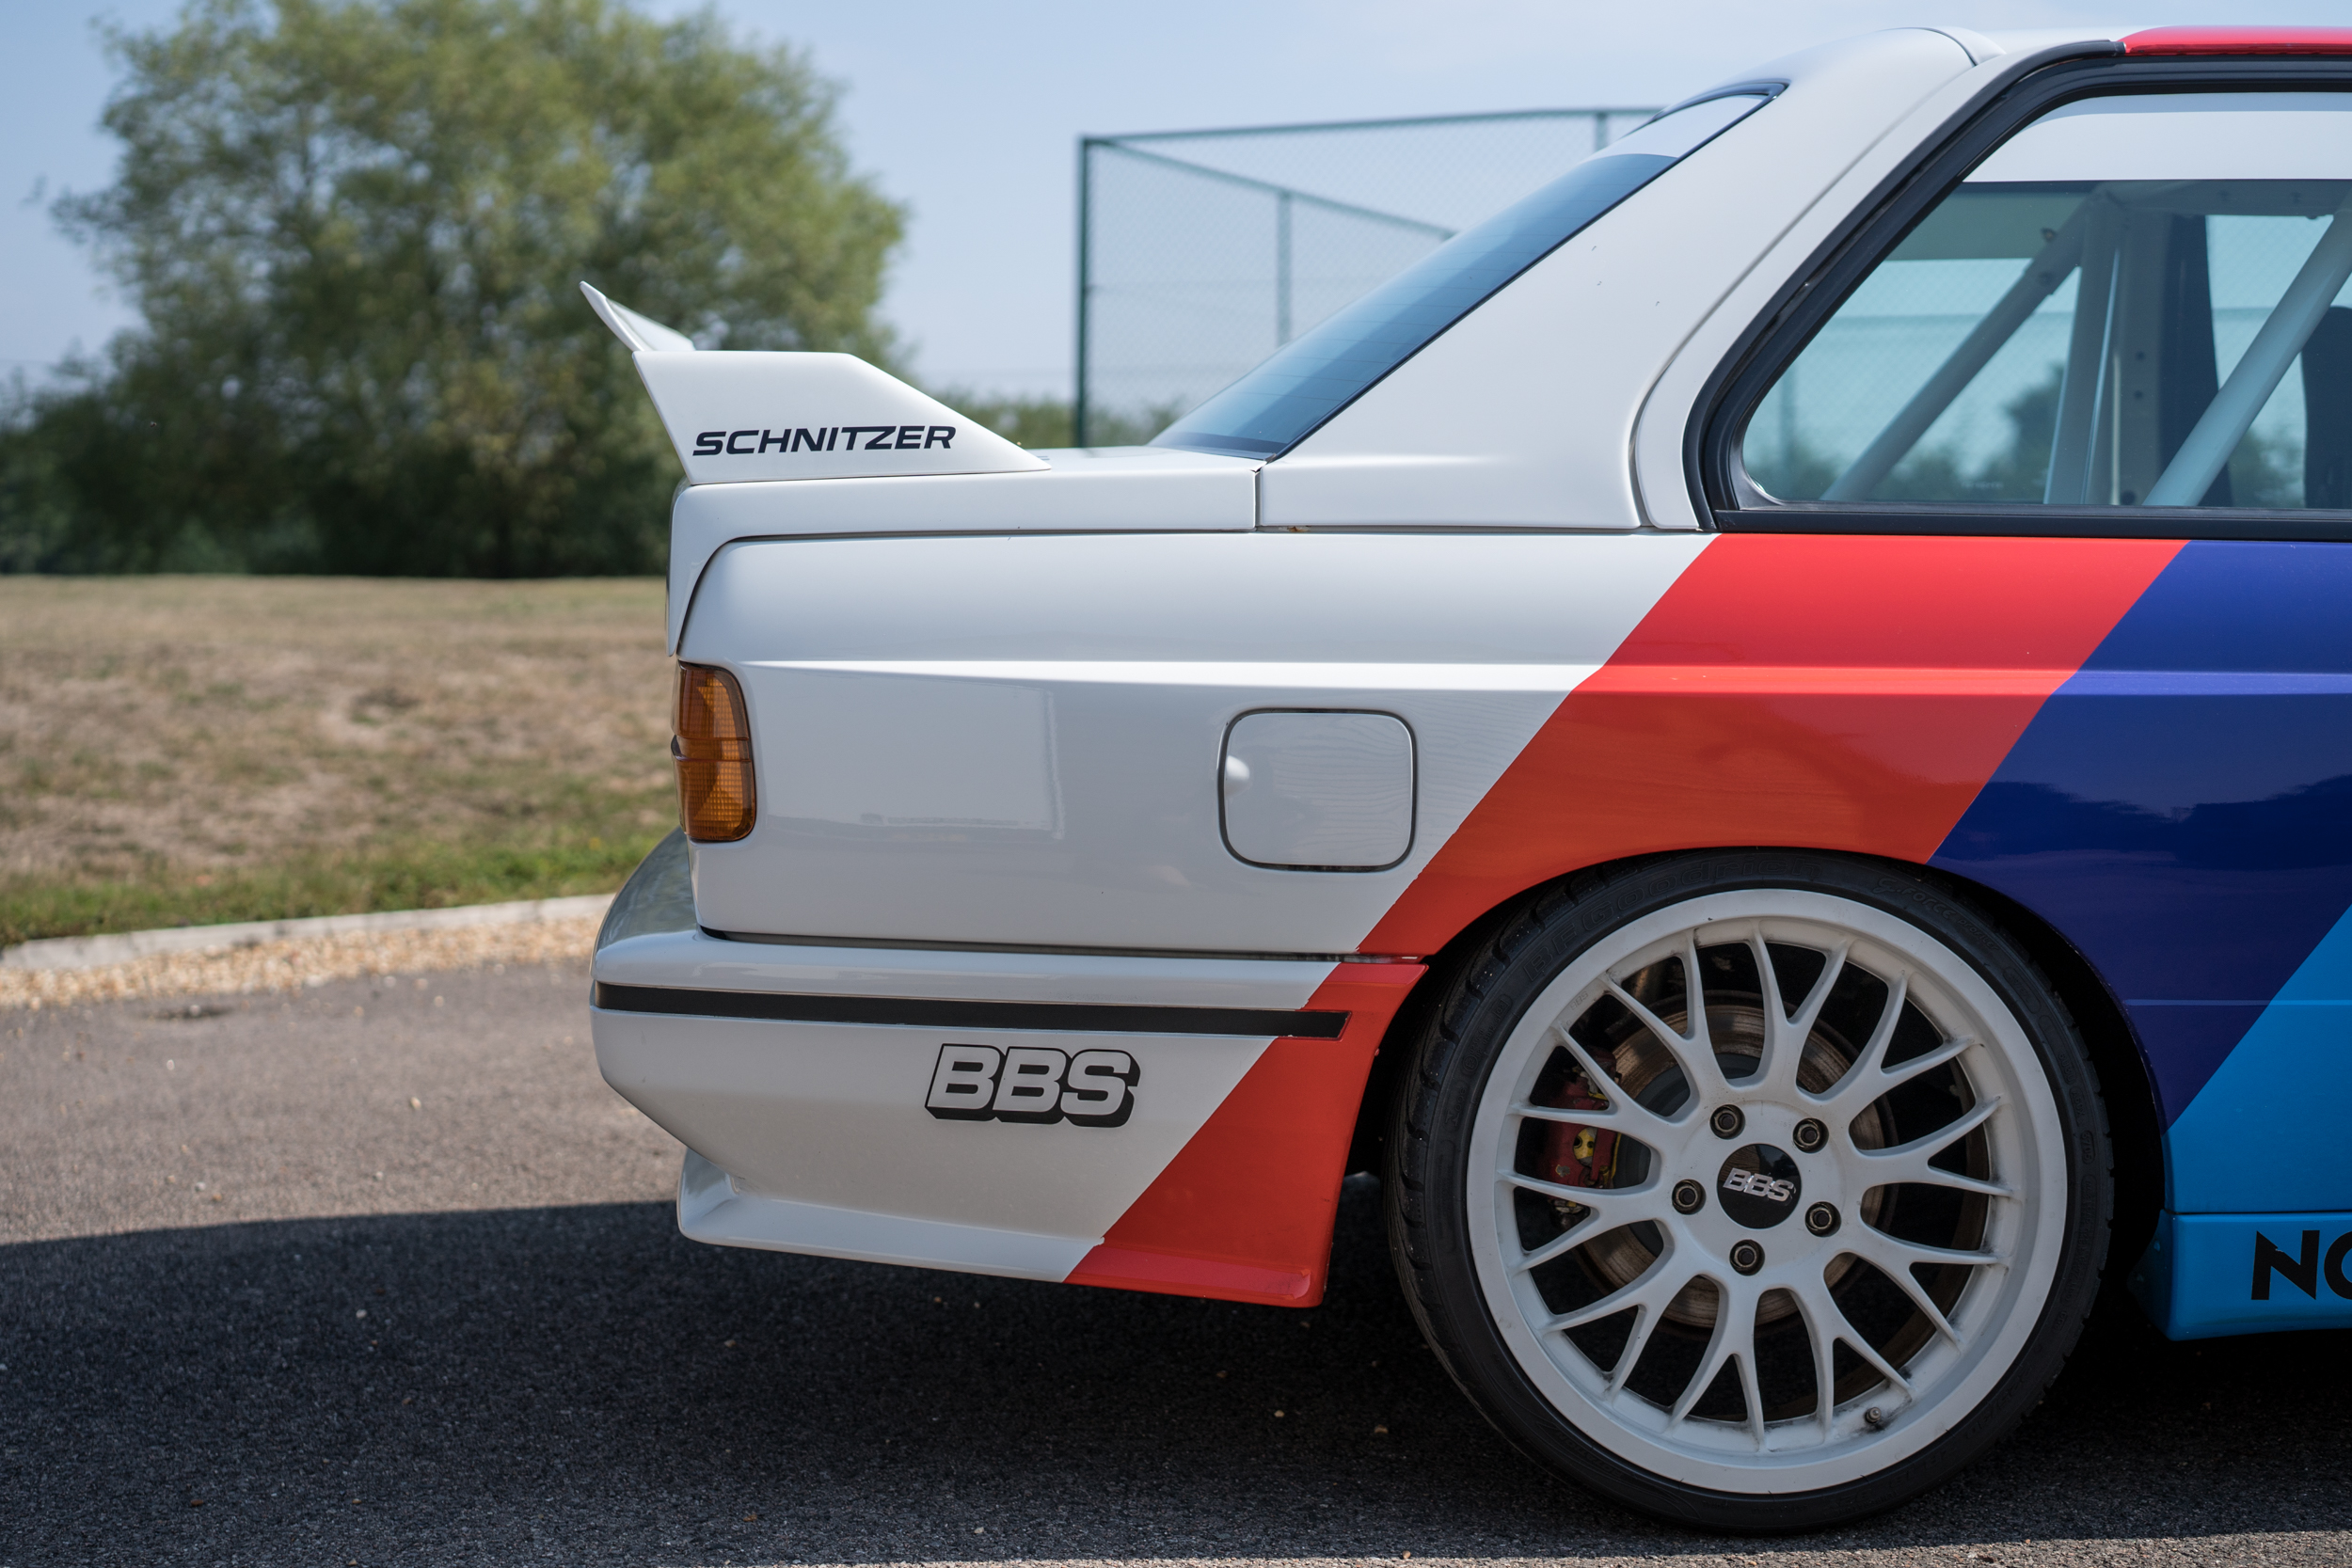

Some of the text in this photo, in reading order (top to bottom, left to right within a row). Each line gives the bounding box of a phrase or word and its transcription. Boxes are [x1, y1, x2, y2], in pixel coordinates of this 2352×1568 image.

[692, 425, 956, 456] SCHNITZER
[1523, 856, 1822, 981] BFGoodrich
[925, 1043, 1141, 1128] BBS
[1723, 1167, 1796, 1203] BBS
